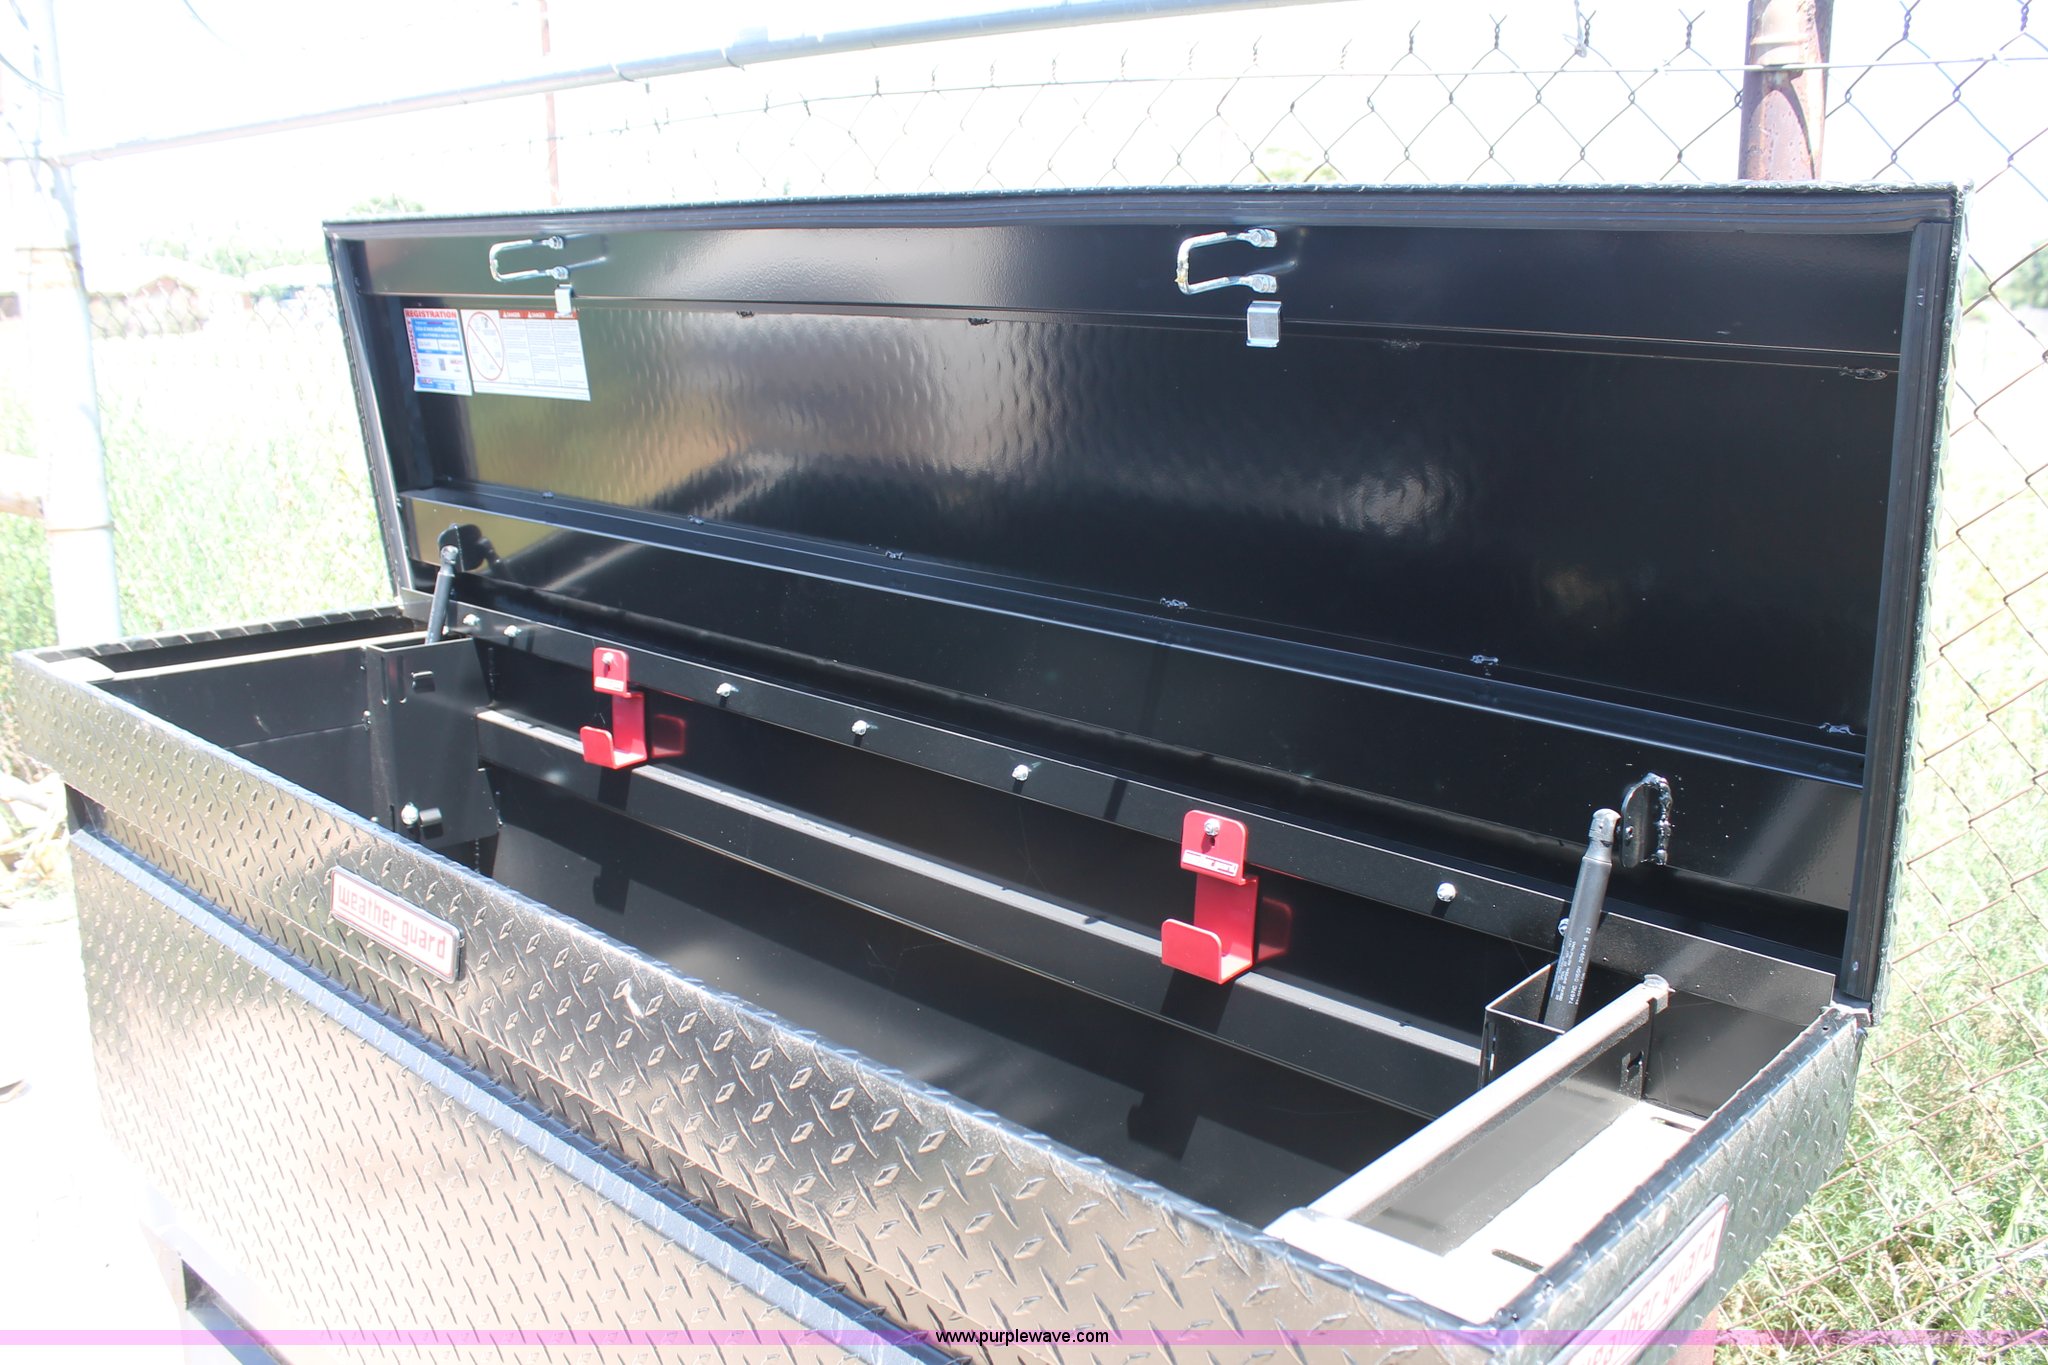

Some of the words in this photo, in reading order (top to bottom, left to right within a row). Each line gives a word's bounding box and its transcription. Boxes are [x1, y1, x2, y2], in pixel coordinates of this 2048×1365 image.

[405, 310, 457, 318] REGISTRATION
[338, 885, 397, 931] weather
[401, 920, 446, 959] guard
[1661, 1226, 1717, 1309] guard
